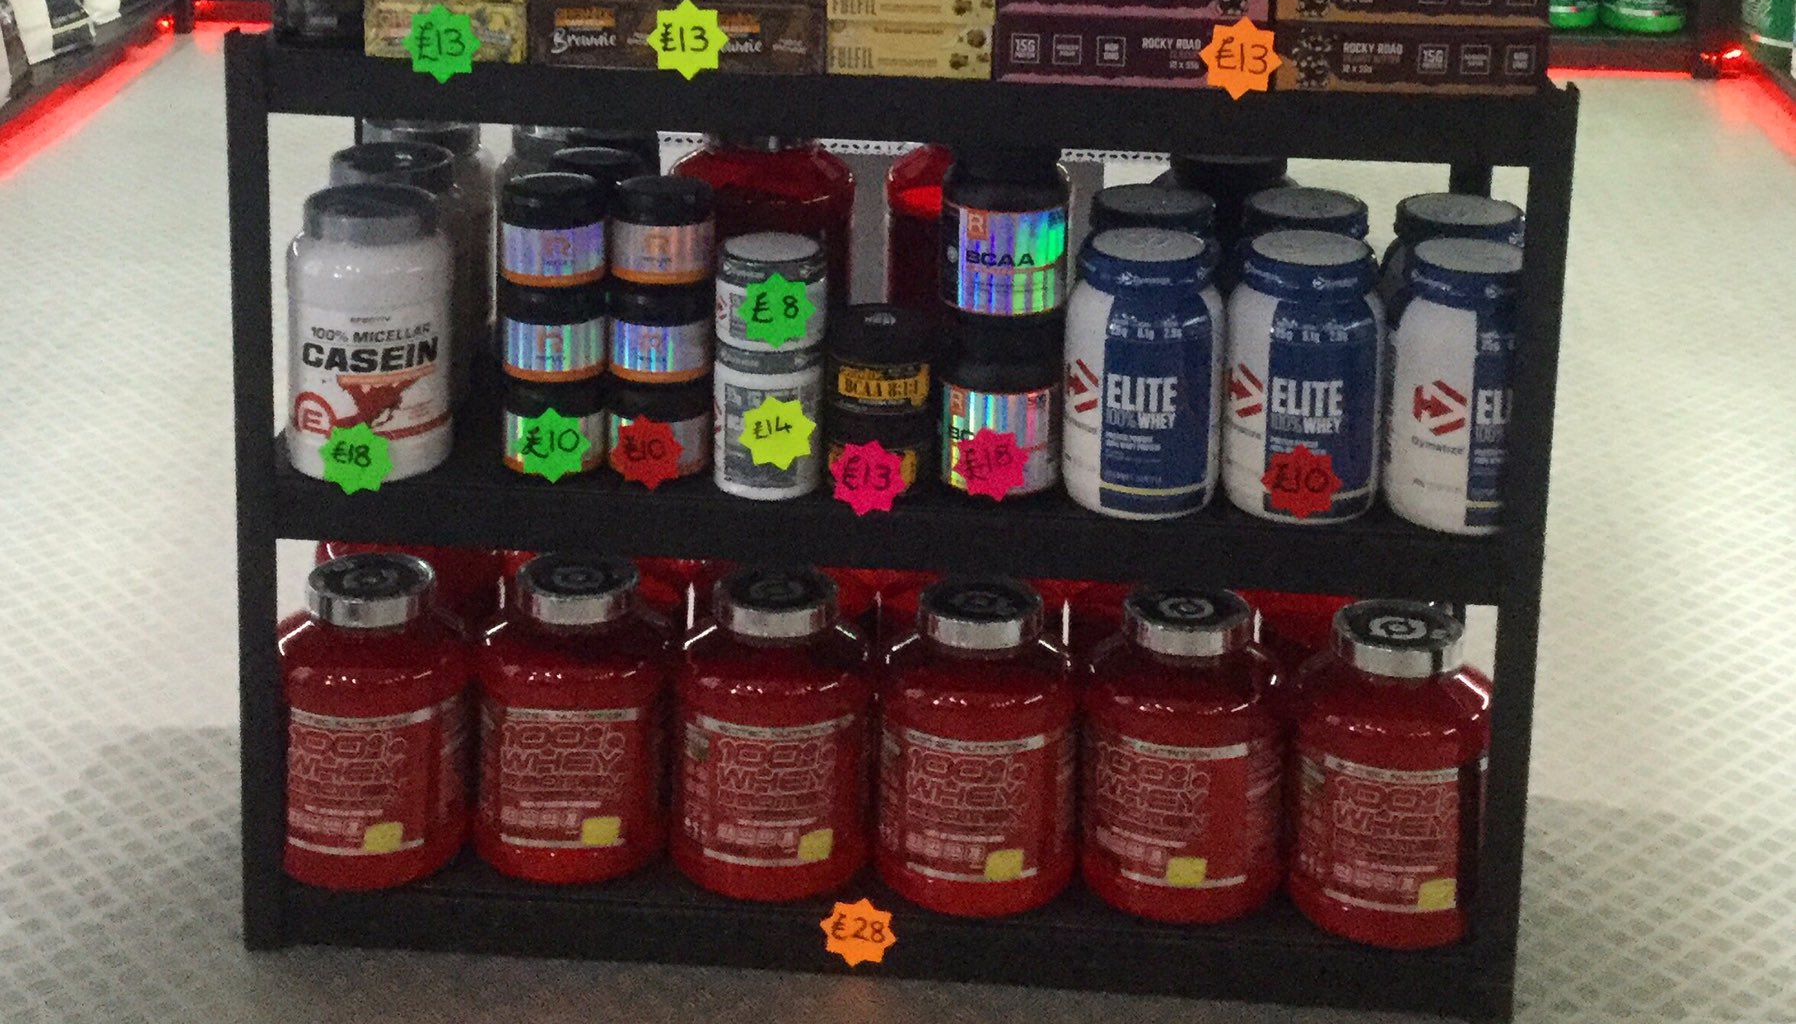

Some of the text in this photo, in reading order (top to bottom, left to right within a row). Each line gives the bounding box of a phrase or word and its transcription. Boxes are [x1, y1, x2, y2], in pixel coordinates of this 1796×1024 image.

[414, 20, 467, 63] £13
[550, 27, 618, 54] Brownie
[660, 22, 710, 53] £13
[1142, 37, 1202, 50] ROCKY ROAD
[1343, 42, 1404, 56] ROCKY ROAD
[830, 46, 874, 69] FULFIL
[1215, 35, 1269, 75] £13
[967, 213, 985, 234] R
[965, 250, 1036, 268] BCAA
[311, 322, 432, 344] 100% MICELLAR
[302, 336, 439, 373] CASEIN
[1106, 373, 1179, 413] ELITE
[1271, 377, 1344, 418] ELITE
[752, 415, 794, 440] £14
[1138, 412, 1177, 430] WHEY
[1302, 416, 1343, 435] WHEY
[330, 440, 373, 469] £18
[520, 426, 581, 459] £10
[841, 454, 893, 492] £13
[501, 723, 626, 753] 100%
[500, 747, 625, 777] WHEY
[717, 740, 838, 769] 100%
[907, 748, 1027, 788] 100%
[717, 764, 833, 797] WHEY
[907, 771, 1024, 810] WHEY
[830, 911, 888, 946] £28
